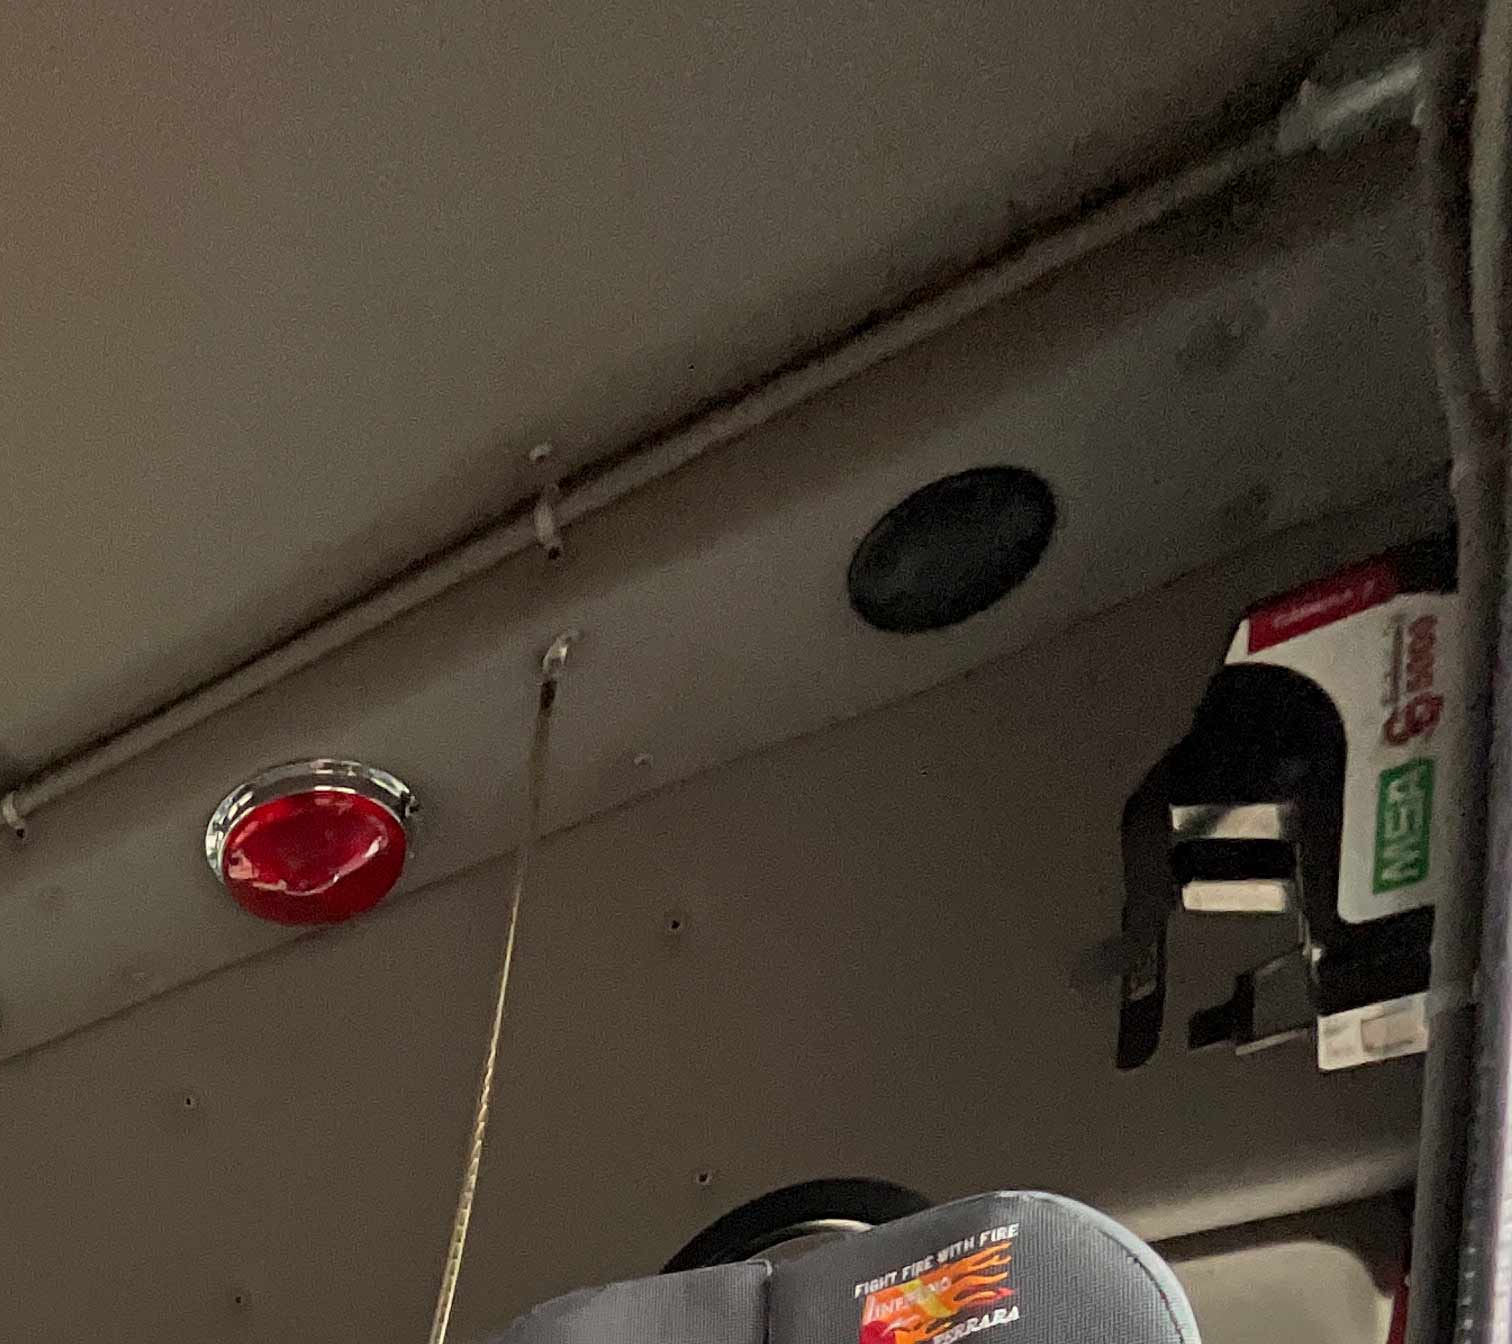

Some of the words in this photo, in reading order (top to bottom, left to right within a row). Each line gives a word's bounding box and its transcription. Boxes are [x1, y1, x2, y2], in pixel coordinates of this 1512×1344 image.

[1379, 769, 1423, 882] MSA
[854, 1271, 898, 1299] FIGHT
[902, 1255, 934, 1281] FIRE
[937, 1236, 975, 1264] WITH
[979, 1223, 1020, 1247] FIRE
